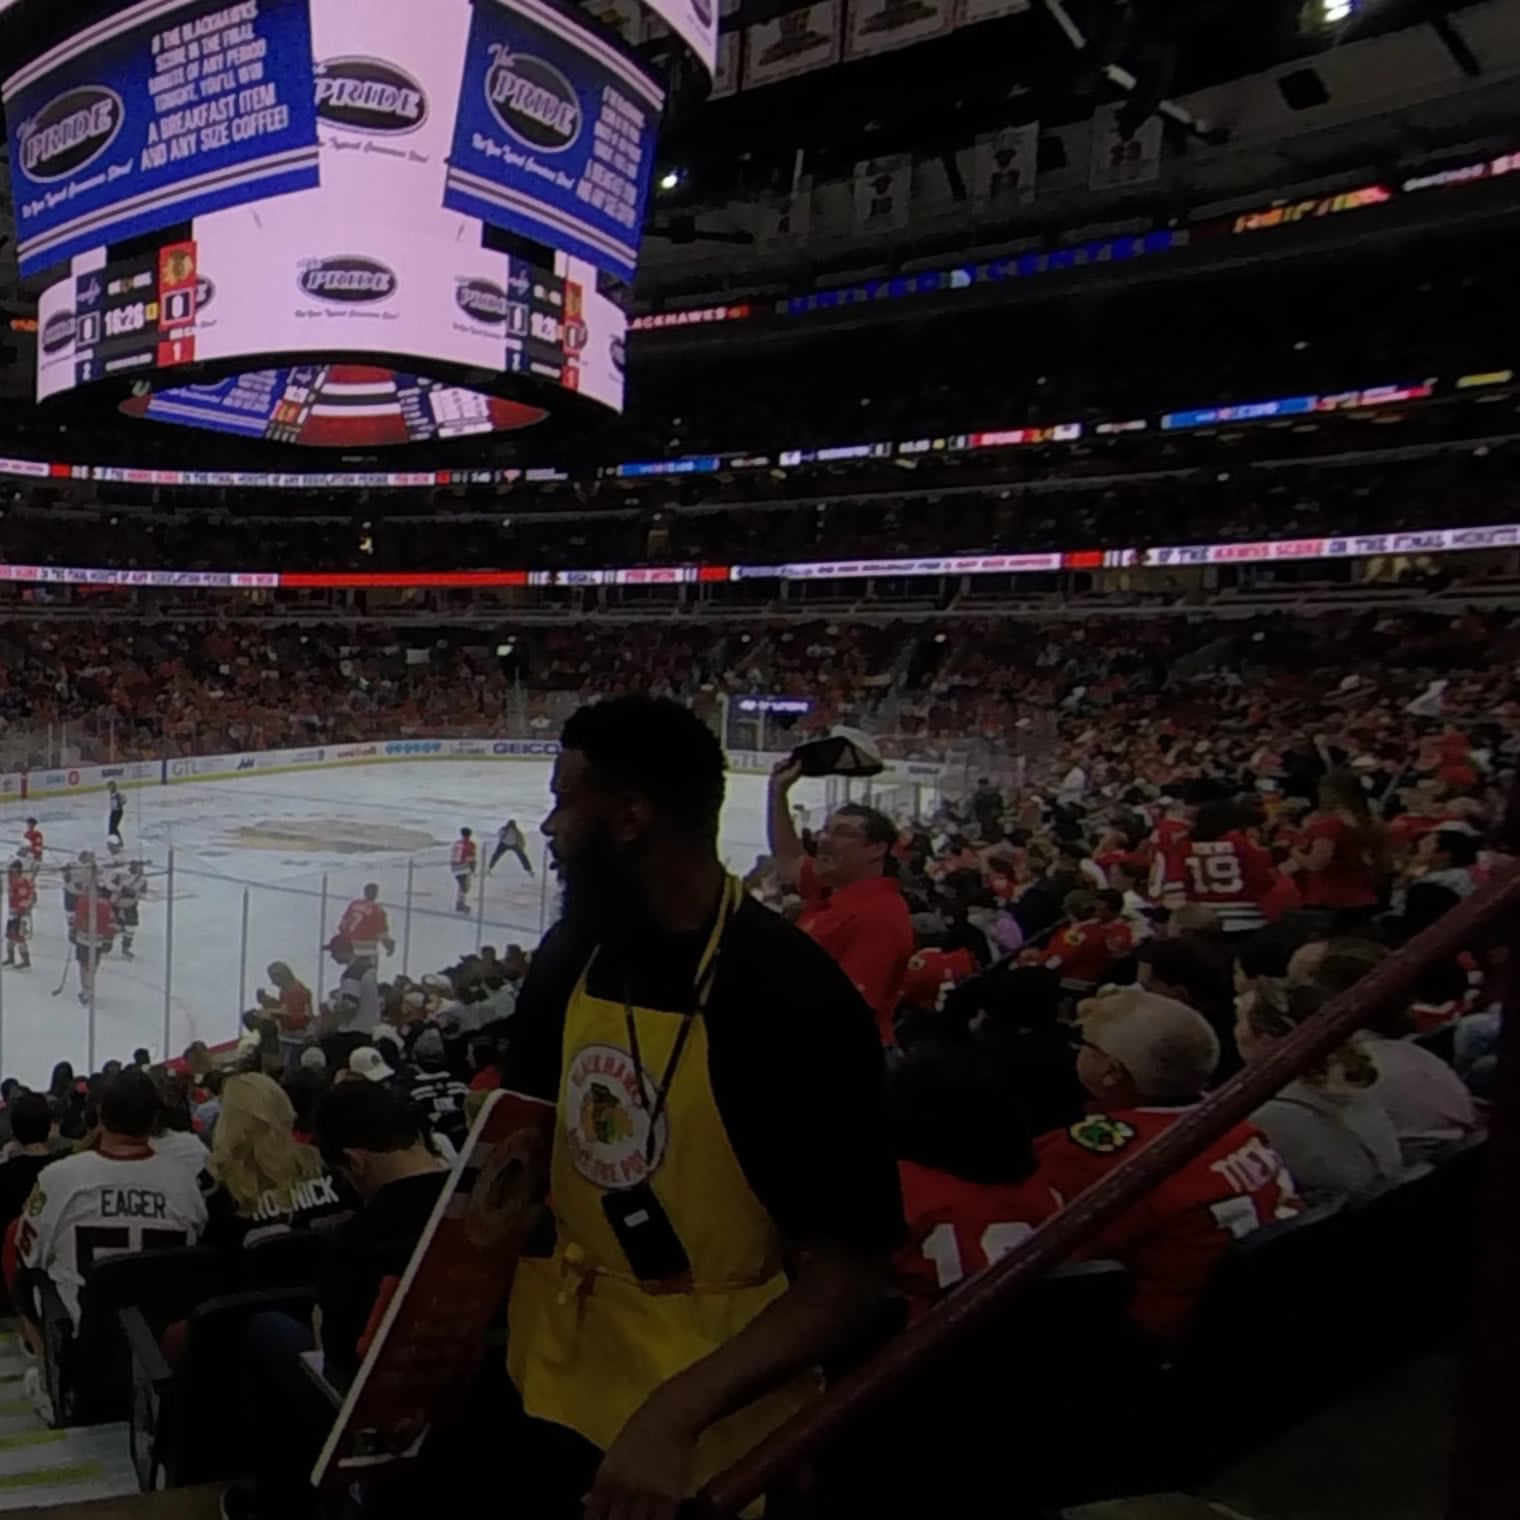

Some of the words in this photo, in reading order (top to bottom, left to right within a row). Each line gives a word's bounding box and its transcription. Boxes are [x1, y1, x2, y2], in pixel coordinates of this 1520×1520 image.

[148, 122, 159, 145] A
[160, 94, 236, 140] BREAKFAST
[239, 82, 276, 115] ITEM
[314, 77, 420, 119] PRIDE
[492, 68, 576, 137] PRIDE
[27, 98, 113, 169] PRIDE
[141, 143, 167, 172] AND
[170, 133, 196, 161] ANY
[200, 122, 230, 152] SIZE
[232, 104, 288, 142] COFFEE!
[306, 270, 390, 292] PRIDE
[171, 294, 184, 319] 0
[630, 307, 727, 329] ACKHAWKS
[493, 742, 559, 755] GEICO
[1185, 854, 1244, 894] 19
[100, 1189, 167, 1220] EAGER
